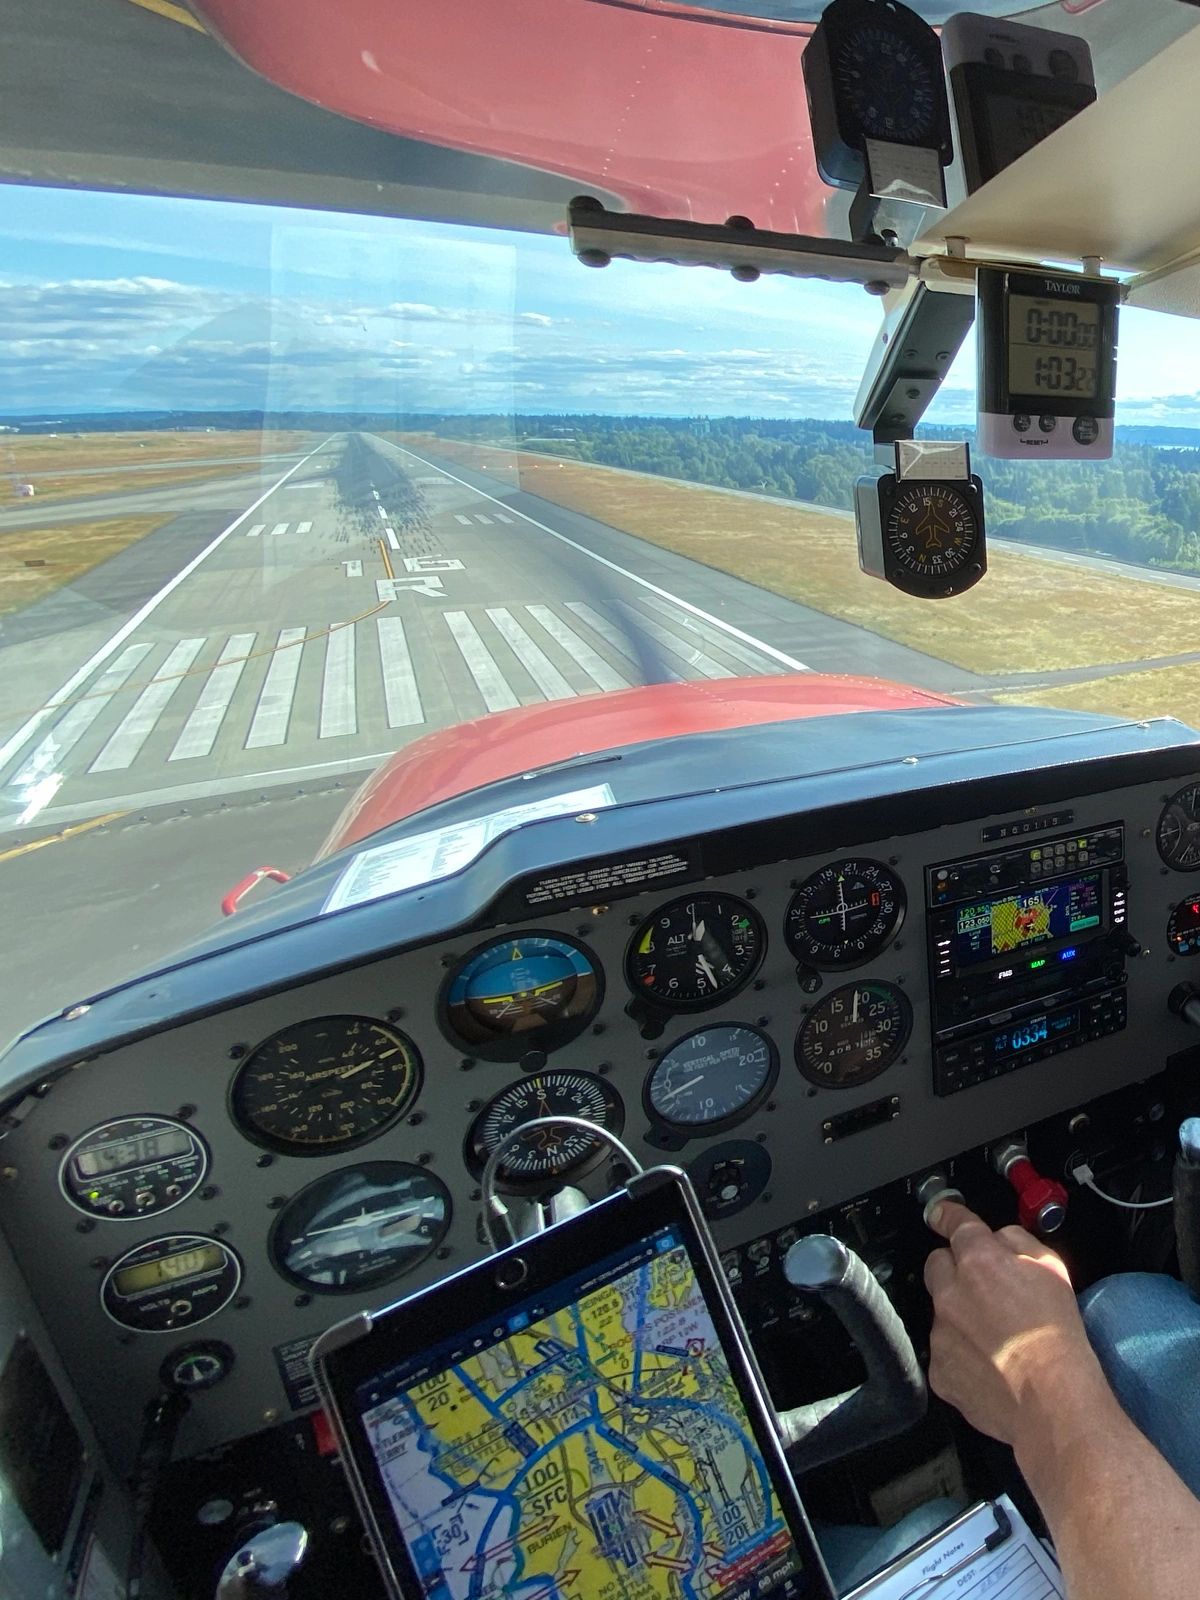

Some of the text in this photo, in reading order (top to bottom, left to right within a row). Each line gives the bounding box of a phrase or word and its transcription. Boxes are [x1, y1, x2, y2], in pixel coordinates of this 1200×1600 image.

[1045, 280, 1080, 295] TAYLOR
[1035, 356, 1077, 391] 1:03
[922, 497, 931, 506] 15
[937, 499, 944, 508] S
[908, 503, 918, 513] 12
[948, 508, 958, 518] 21
[955, 522, 964, 532] 24
[954, 538, 963, 546] W
[906, 546, 915, 554] 3
[945, 548, 956, 558] 30
[918, 554, 927, 563] N
[932, 555, 943, 565] 33
[341, 554, 466, 577] 16
[376, 576, 448, 601] R
[844, 863, 857, 872] 21
[866, 866, 880, 878] 24
[820, 868, 833, 880] 18
[800, 886, 812, 897] 15
[880, 880, 893, 892] 27
[1023, 896, 1041, 908] 165
[884, 902, 894, 914] 30
[731, 915, 741, 926] 2
[791, 909, 801, 921] 12
[660, 918, 671, 929] 9
[874, 923, 886, 935] 33
[667, 934, 686, 946] ALT
[735, 945, 745, 956] 3
[810, 945, 819, 954] 6
[834, 949, 841, 958] 3
[1062, 950, 1076, 960] AUX
[647, 964, 657, 975] 7
[722, 963, 734, 974] 4
[1031, 960, 1046, 969] MAP
[998, 970, 1013, 980] FMS
[668, 978, 679, 989] 6
[697, 978, 706, 989] 5
[832, 1000, 844, 1014] 15
[869, 1002, 886, 1017] 25
[815, 1020, 829, 1034] 10
[876, 1019, 892, 1033] 30
[1012, 1021, 1048, 1049] 0334
[375, 1038, 387, 1046] 60
[692, 1036, 706, 1049] 10
[279, 1044, 298, 1054] 200
[814, 1042, 823, 1055] 5
[866, 1046, 882, 1061] 35
[739, 1053, 755, 1067] 20
[304, 1064, 355, 1082] AIRSPEED
[824, 1062, 833, 1074] 0
[289, 1071, 305, 1080] 160
[537, 1088, 547, 1100] S
[556, 1087, 568, 1096] 21
[516, 1099, 529, 1109] 15
[571, 1093, 585, 1104] 24
[700, 1098, 714, 1110] 10
[308, 1104, 323, 1113] 120
[578, 1104, 593, 1116] W
[502, 1114, 516, 1124] 12
[564, 1136, 579, 1147] 33
[546, 1146, 558, 1157] N
[192, 1284, 219, 1297] AMPS
[140, 1298, 170, 1312] VOLTS
[427, 1391, 449, 1412] 20
[522, 1461, 560, 1493] 100
[532, 1485, 568, 1517] SFC
[527, 1522, 573, 1555] BURIEN
[922, 1542, 966, 1576] Flight Notes
[773, 1562, 795, 1578] mph
